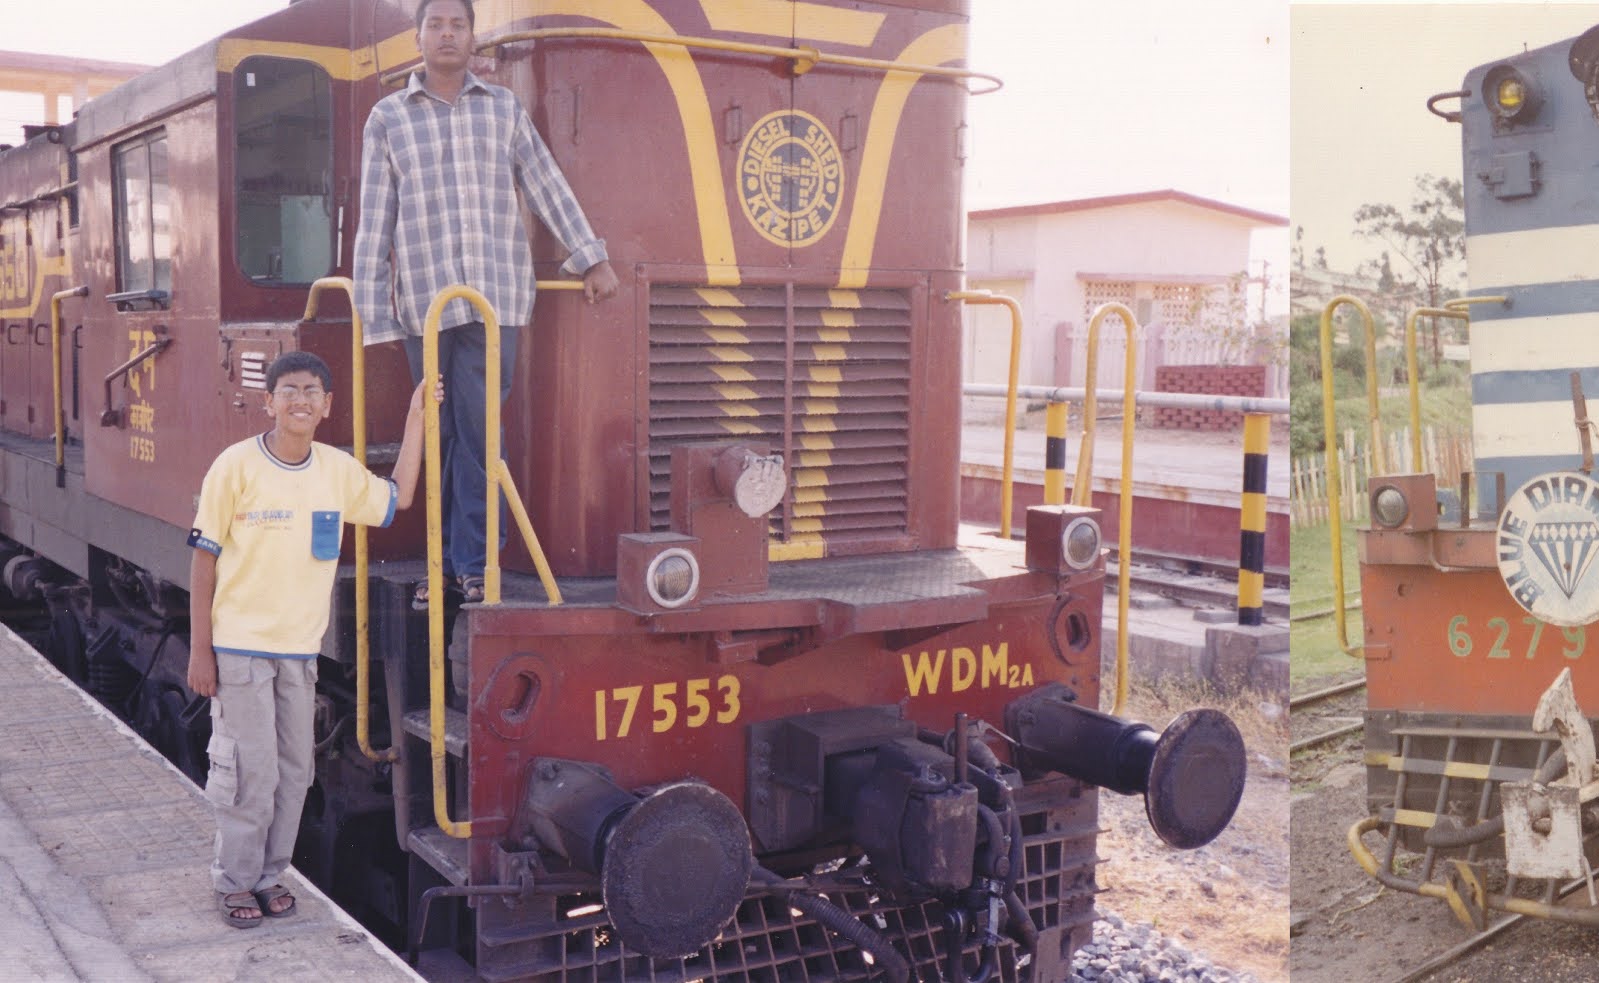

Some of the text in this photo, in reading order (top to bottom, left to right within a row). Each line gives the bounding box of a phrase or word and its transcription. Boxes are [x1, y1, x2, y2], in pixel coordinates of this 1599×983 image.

[744, 118, 838, 179] DIESEL SHED
[746, 193, 833, 240] KAZIPET
[130, 435, 155, 462] 17553
[1500, 510, 1544, 611] BLUE
[595, 674, 741, 741] 17553
